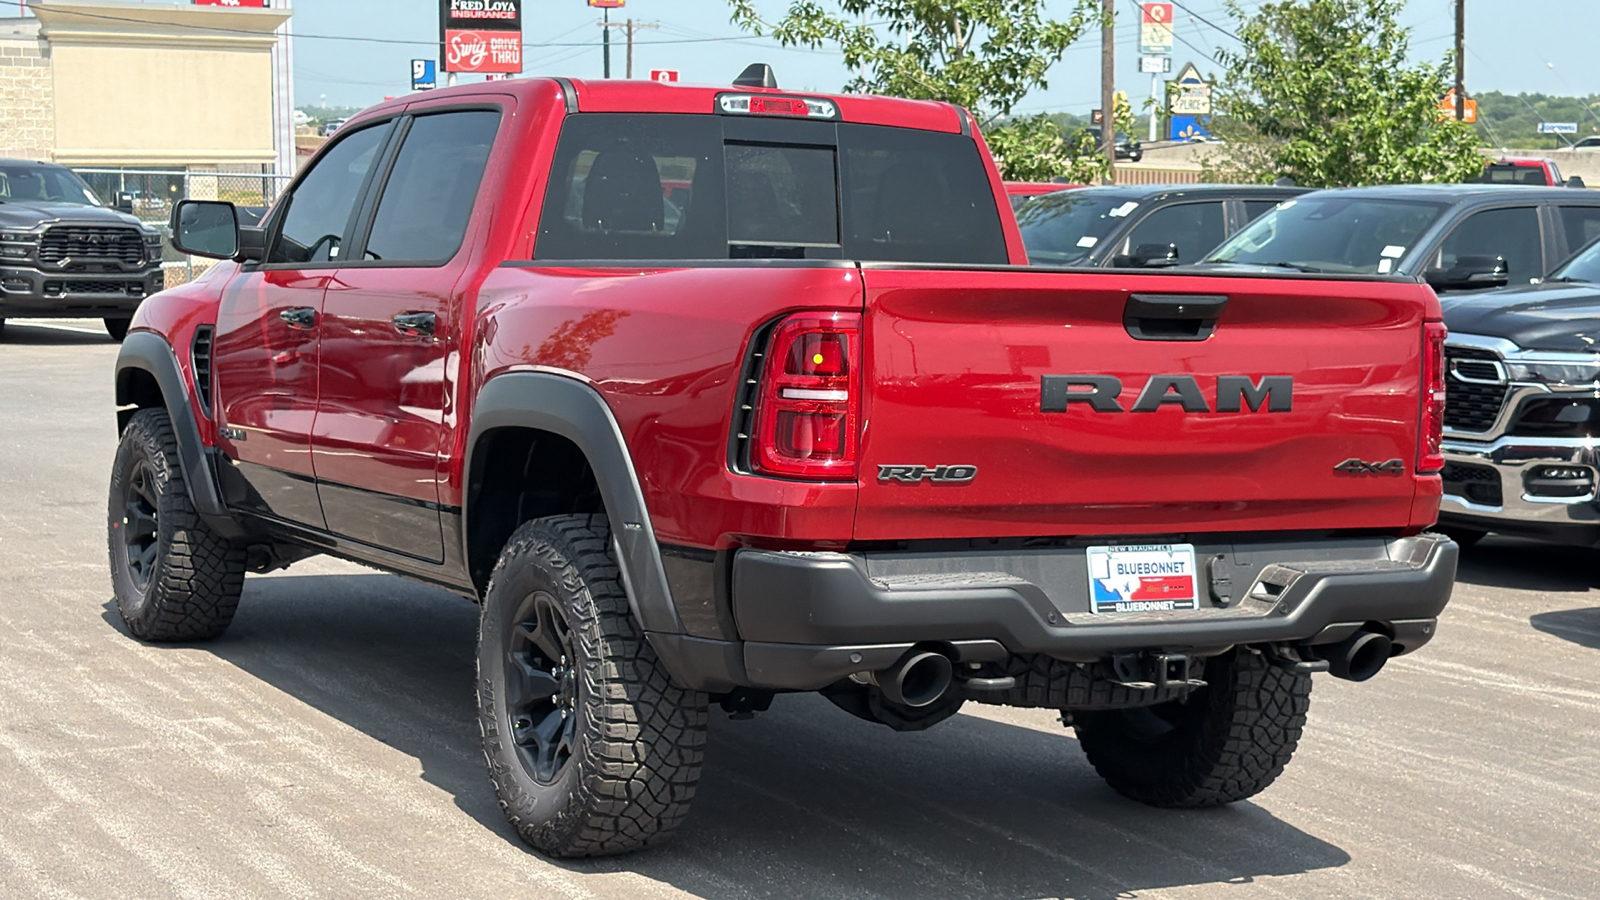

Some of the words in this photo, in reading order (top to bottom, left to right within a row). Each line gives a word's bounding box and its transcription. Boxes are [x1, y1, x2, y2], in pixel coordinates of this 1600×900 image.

[452, 10, 516, 18] INSURANCE
[448, 36, 488, 65] Swig
[490, 38, 519, 50] DRIVE
[492, 51, 520, 63] THRU
[1040, 374, 1293, 413] RAM
[877, 464, 978, 482] RHO
[1117, 562, 1185, 575] BLUEBONNET
[1115, 601, 1175, 612] BLUEBONNET
